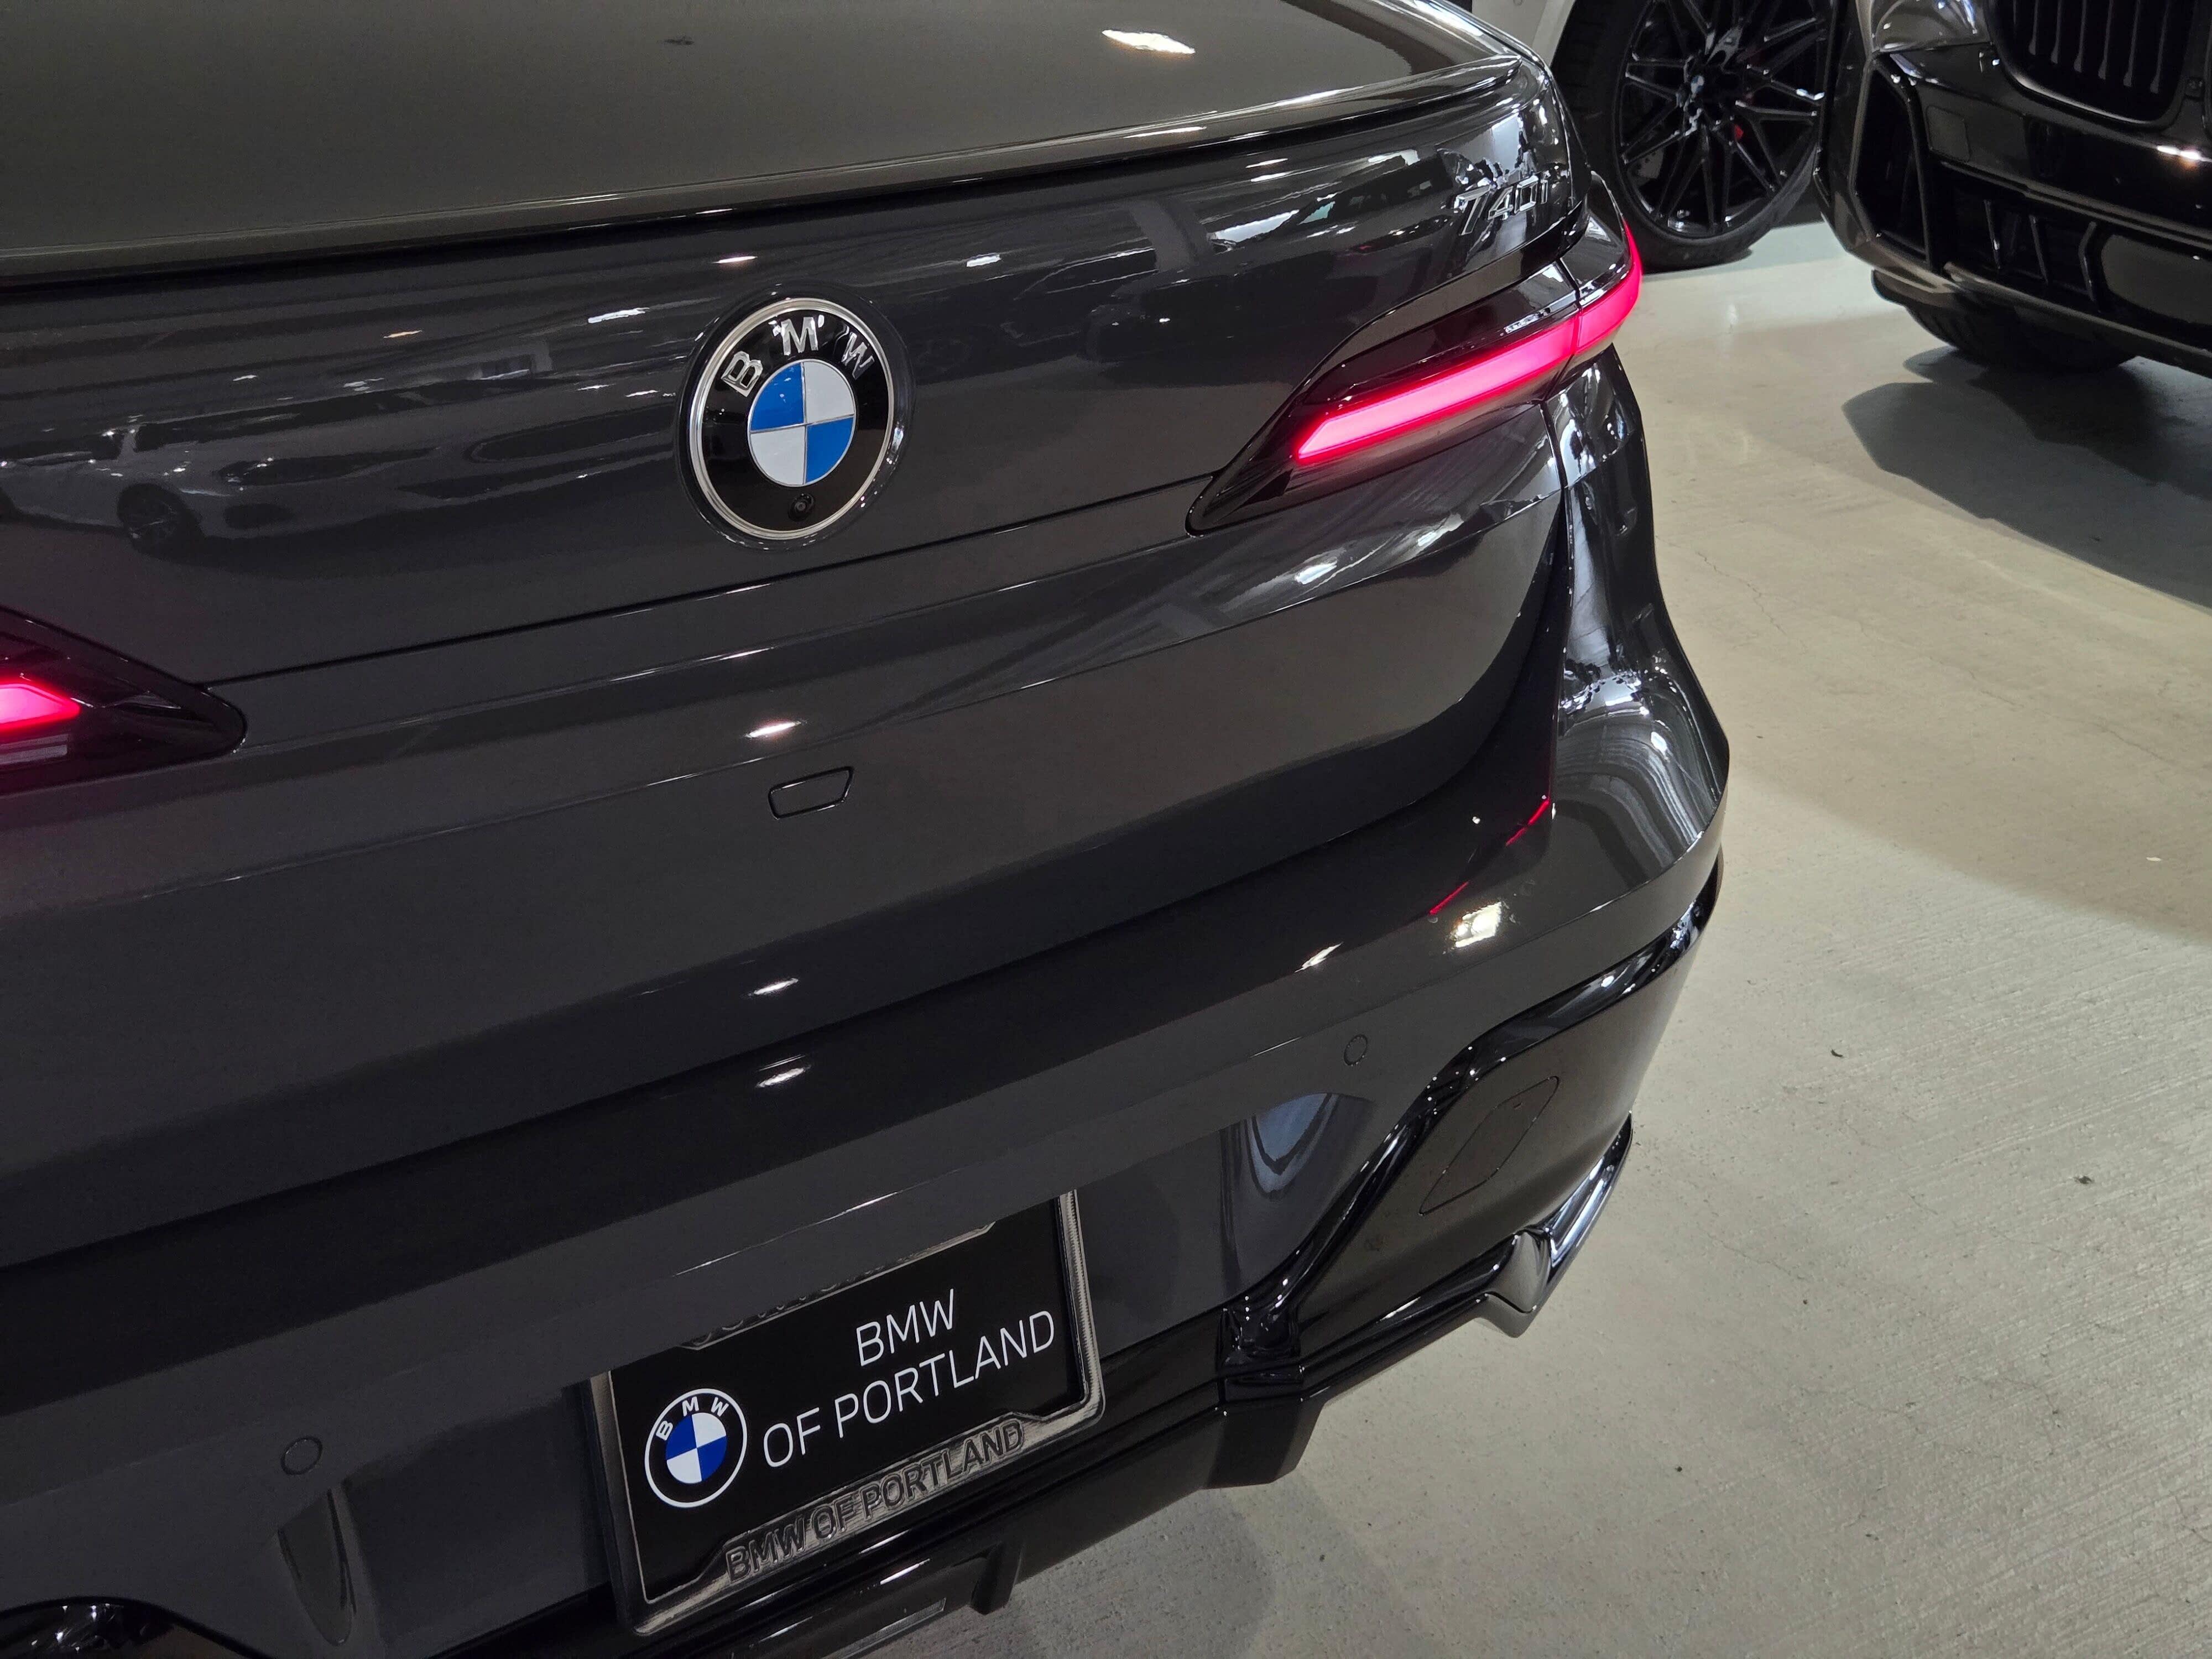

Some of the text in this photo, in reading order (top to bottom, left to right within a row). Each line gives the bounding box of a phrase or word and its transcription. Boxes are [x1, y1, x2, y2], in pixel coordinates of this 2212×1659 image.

[721, 317, 874, 397] BMW
[856, 1288, 954, 1367] BMW
[656, 1396, 729, 1441] BMW
[764, 1311, 1054, 1467] OF PORTLAND
[726, 1418, 1025, 1582] BMW OF PORTLAND
